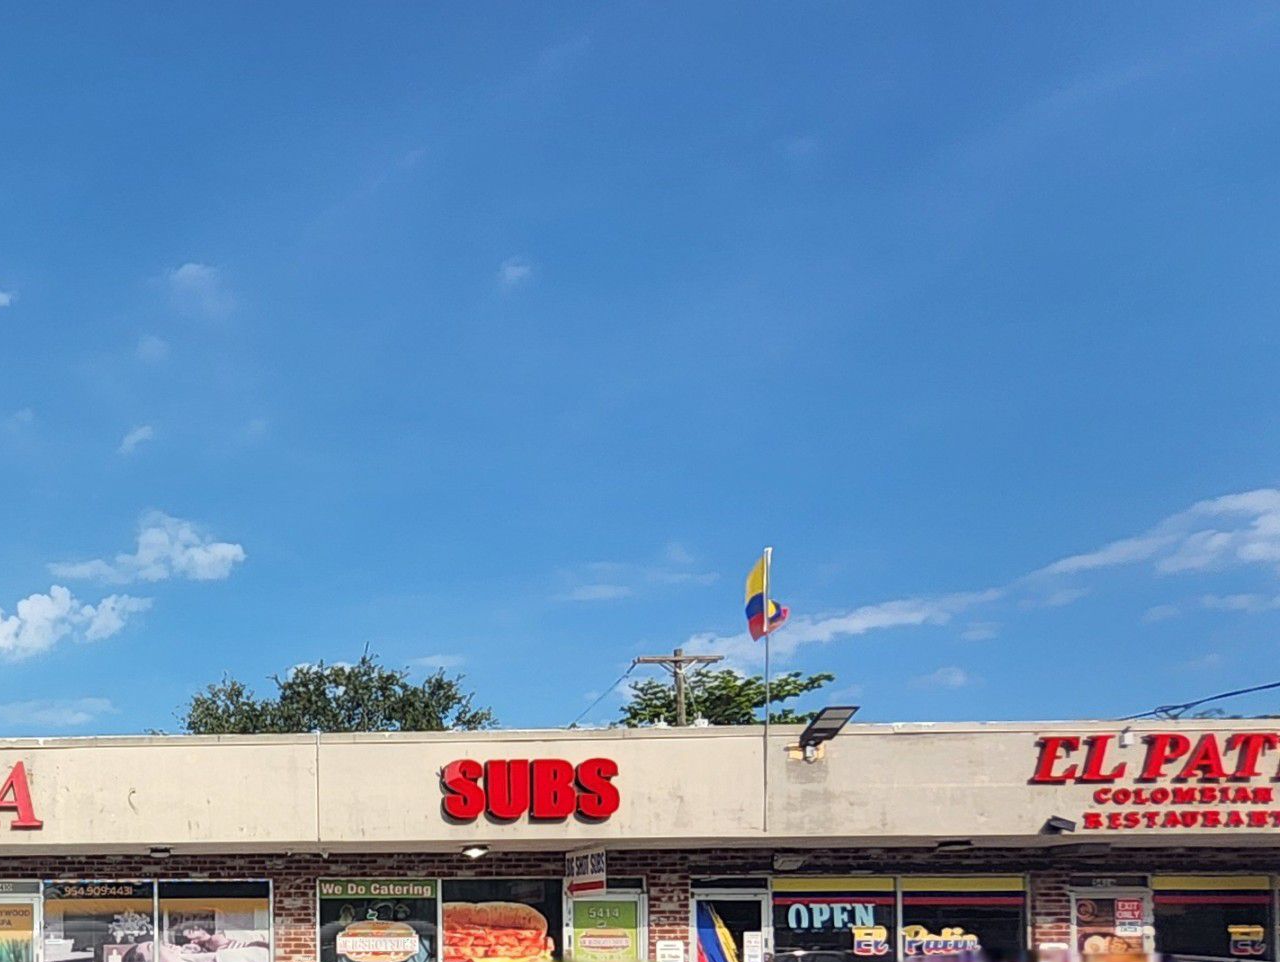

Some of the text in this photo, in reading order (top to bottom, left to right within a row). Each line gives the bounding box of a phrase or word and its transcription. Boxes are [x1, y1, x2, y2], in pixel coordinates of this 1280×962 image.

[1031, 733, 1280, 782] EL PAT
[441, 758, 620, 823] SUBS
[1092, 786, 1274, 805] COLOMBIAN
[321, 883, 432, 896] We Do Catering
[788, 903, 875, 929] OPEN
